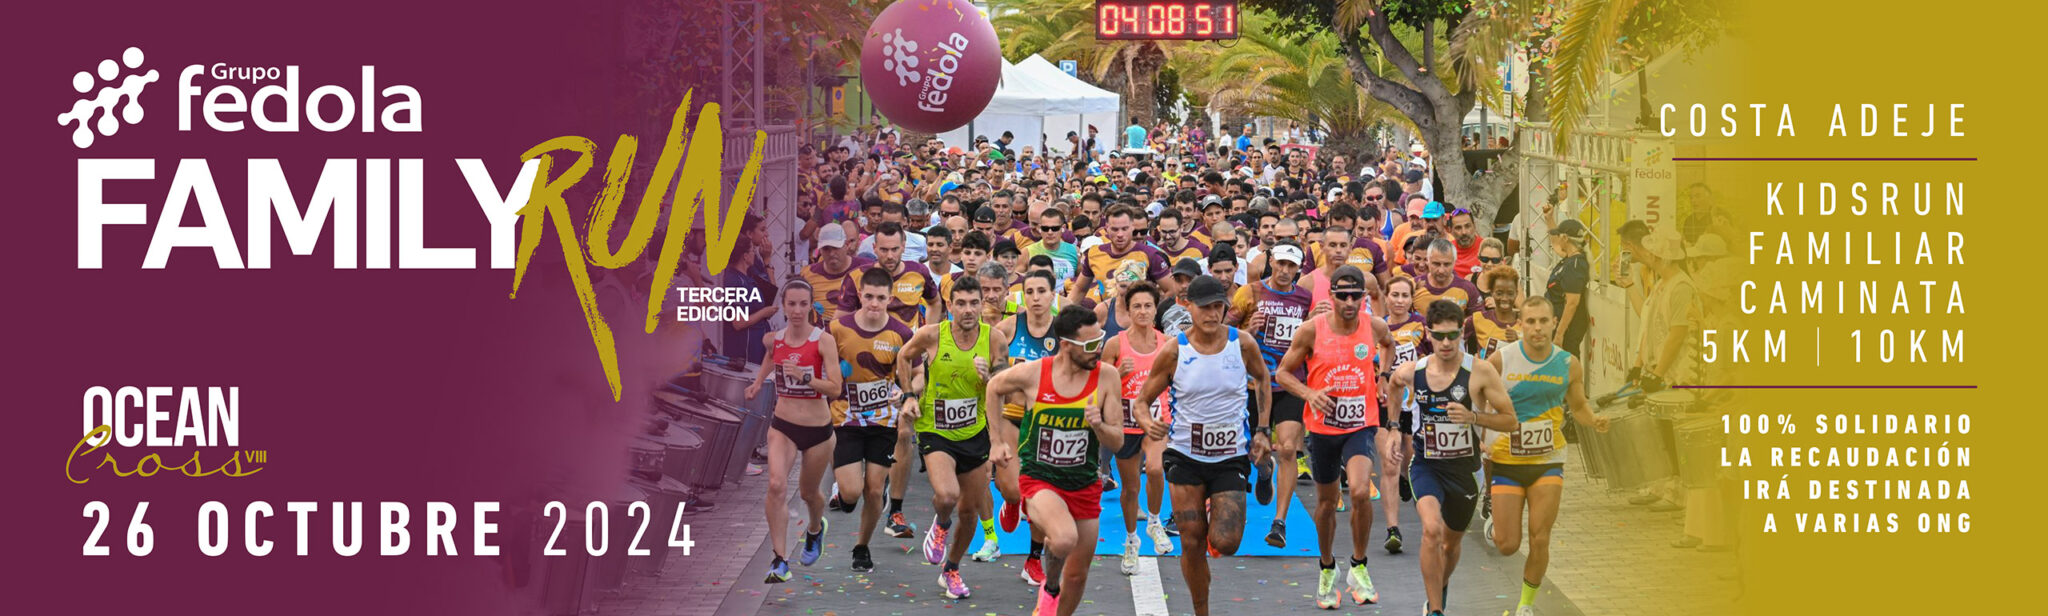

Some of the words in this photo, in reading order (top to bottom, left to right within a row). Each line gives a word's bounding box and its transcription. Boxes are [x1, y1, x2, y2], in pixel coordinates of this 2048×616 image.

[918, 32, 969, 112] fedola
[919, 75, 932, 100] Grupo
[1635, 168, 1671, 180] fedola
[1507, 373, 1564, 385] CANARIAS
[860, 385, 887, 403] 066
[947, 404, 976, 420] 067
[1338, 404, 1365, 419] 033
[1204, 430, 1237, 447] 082
[1438, 430, 1469, 447] 071
[1523, 428, 1552, 445] 270
[1053, 438, 1087, 455] 072
